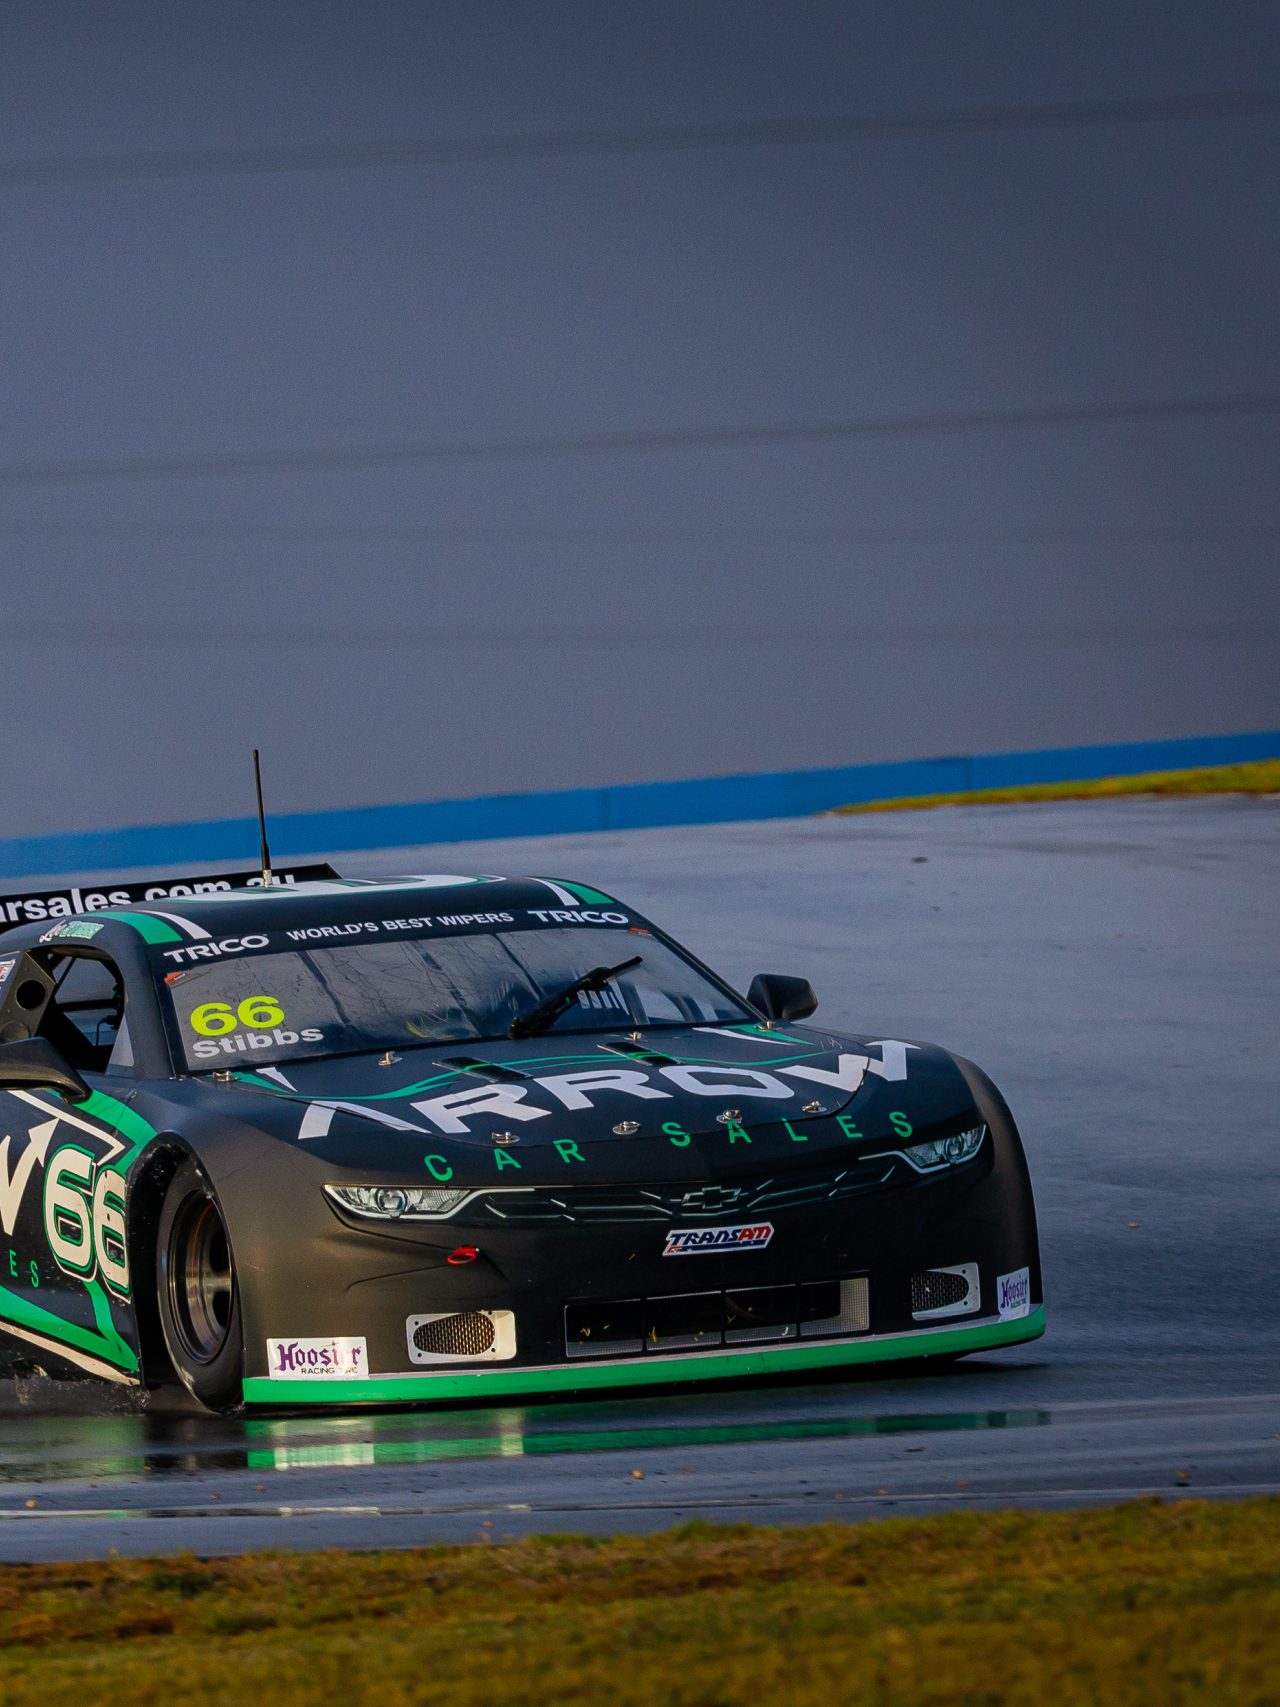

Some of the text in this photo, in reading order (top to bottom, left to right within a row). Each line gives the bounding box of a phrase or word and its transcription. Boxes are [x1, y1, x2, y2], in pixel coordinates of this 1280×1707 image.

[286, 912, 514, 941] WORLD'S BEST WIPERS
[527, 910, 629, 924] TRICO
[163, 935, 269, 963] TRICO
[190, 995, 285, 1036] 66
[192, 1028, 324, 1059] Stibbs
[297, 1039, 922, 1140] ARROW
[424, 1111, 914, 1182] CAR SALES
[43, 1143, 131, 1294] 66
[275, 1340, 362, 1371] Hoosir
[301, 1367, 336, 1375] RACING
